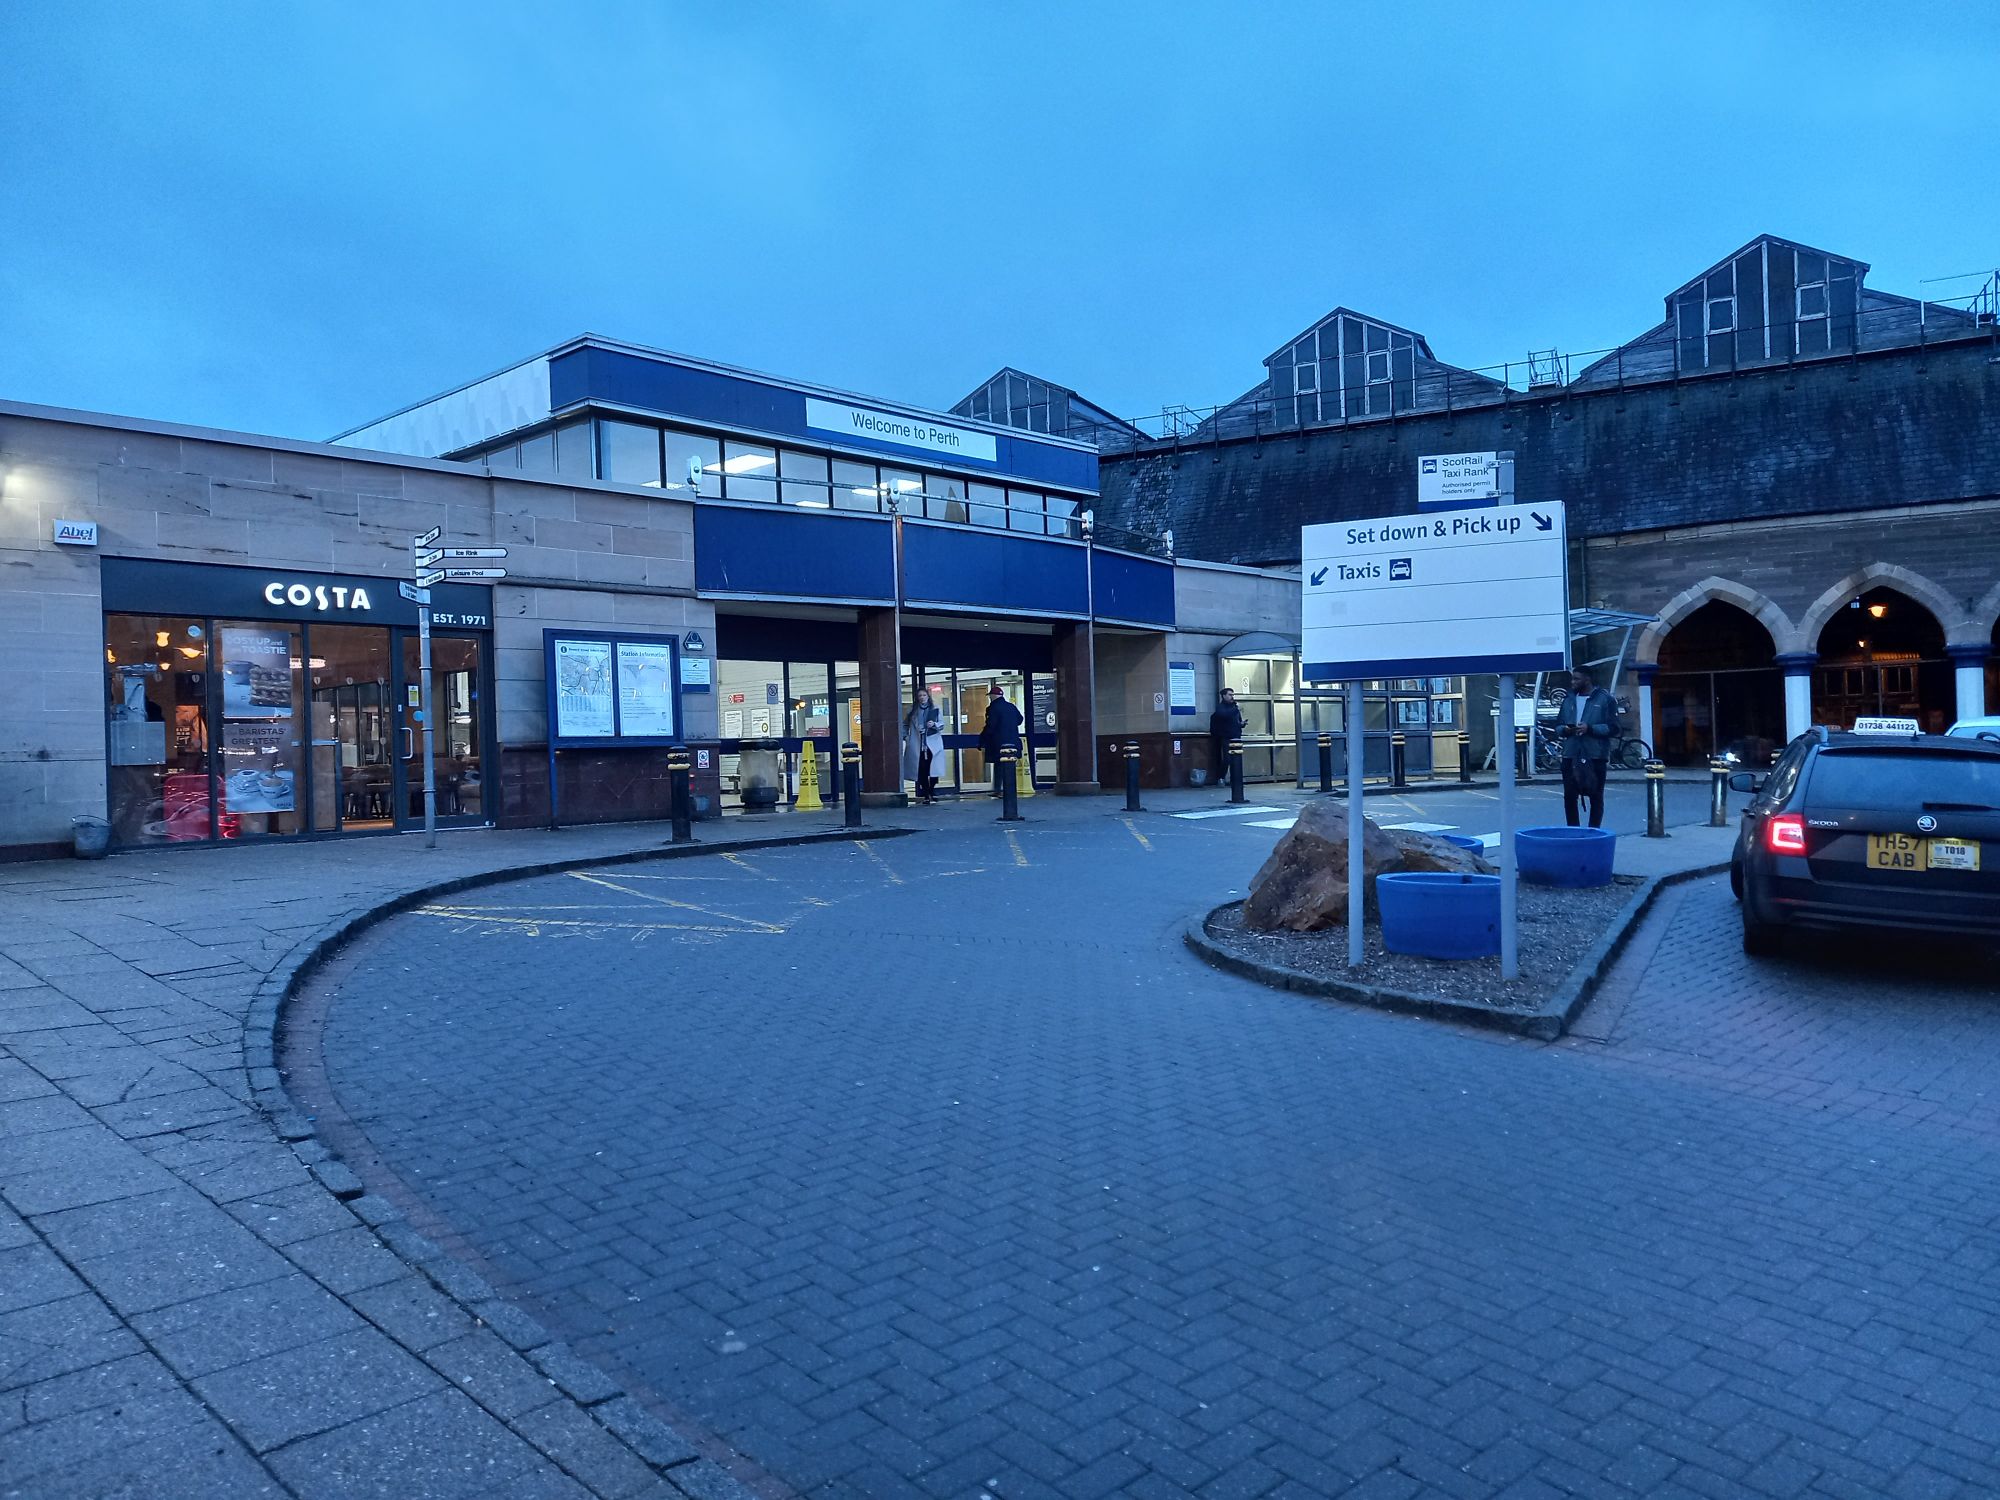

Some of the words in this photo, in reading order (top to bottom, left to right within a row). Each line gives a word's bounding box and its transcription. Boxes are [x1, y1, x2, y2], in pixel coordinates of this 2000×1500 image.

[852, 412, 910, 437] Welcome
[914, 425, 926, 440] to
[929, 428, 960, 446] Perth
[1442, 456, 1483, 466] ScotRail
[1442, 468, 1460, 478] Taxi
[1464, 467, 1489, 477] Rank
[60, 526, 93, 538] Abel
[1347, 529, 1375, 544] Set
[1380, 525, 1427, 542] down
[1433, 520, 1446, 537] &
[1453, 516, 1491, 535] Pick
[1497, 517, 1521, 534] up
[1337, 562, 1381, 580] Taxis
[264, 582, 371, 611] COSTA
[433, 613, 457, 624] EST.
[461, 614, 486, 626] 1971
[256, 637, 270, 646] UP
[241, 645, 287, 655] TOASTIE
[239, 727, 286, 735] BARISTAS'
[1873, 833, 1920, 851] TH57
[1878, 852, 1914, 867] CAB
